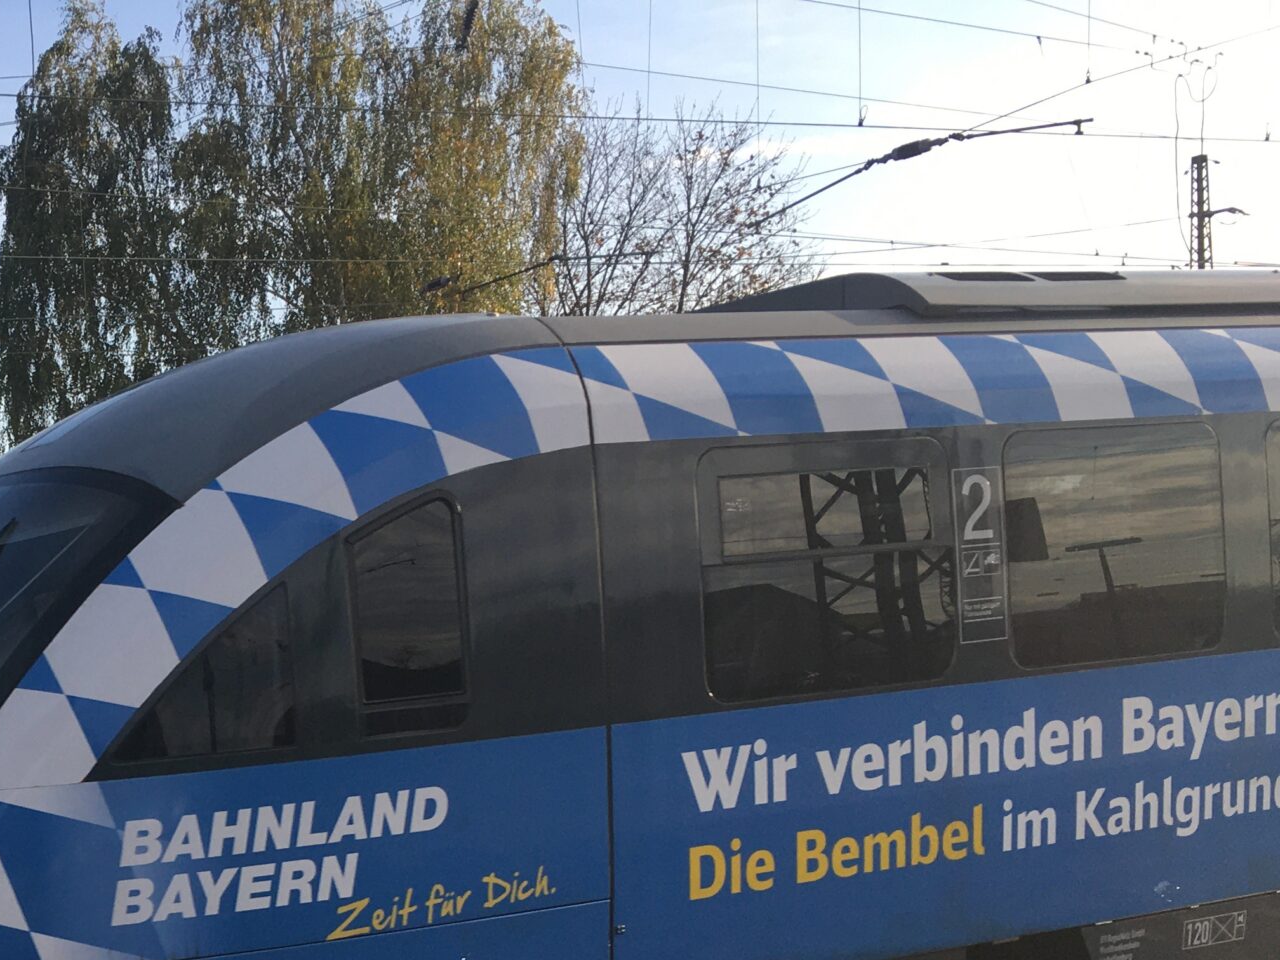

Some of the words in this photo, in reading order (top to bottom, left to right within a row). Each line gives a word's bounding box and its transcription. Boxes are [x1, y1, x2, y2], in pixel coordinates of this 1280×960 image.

[961, 474, 994, 540] 2
[682, 739, 797, 812] Wir
[816, 709, 1102, 794] verbinden
[120, 786, 448, 866] BAHNLAND
[690, 839, 775, 900] Die
[797, 805, 984, 883] Bembel
[1003, 799, 1056, 851] im
[1075, 774, 1280, 838] Kahlgrun
[112, 853, 358, 926] BAYERN
[326, 891, 418, 940] Zeit
[425, 884, 472, 923] für
[482, 865, 557, 908] Dich.
[1186, 920, 1210, 946] 120
